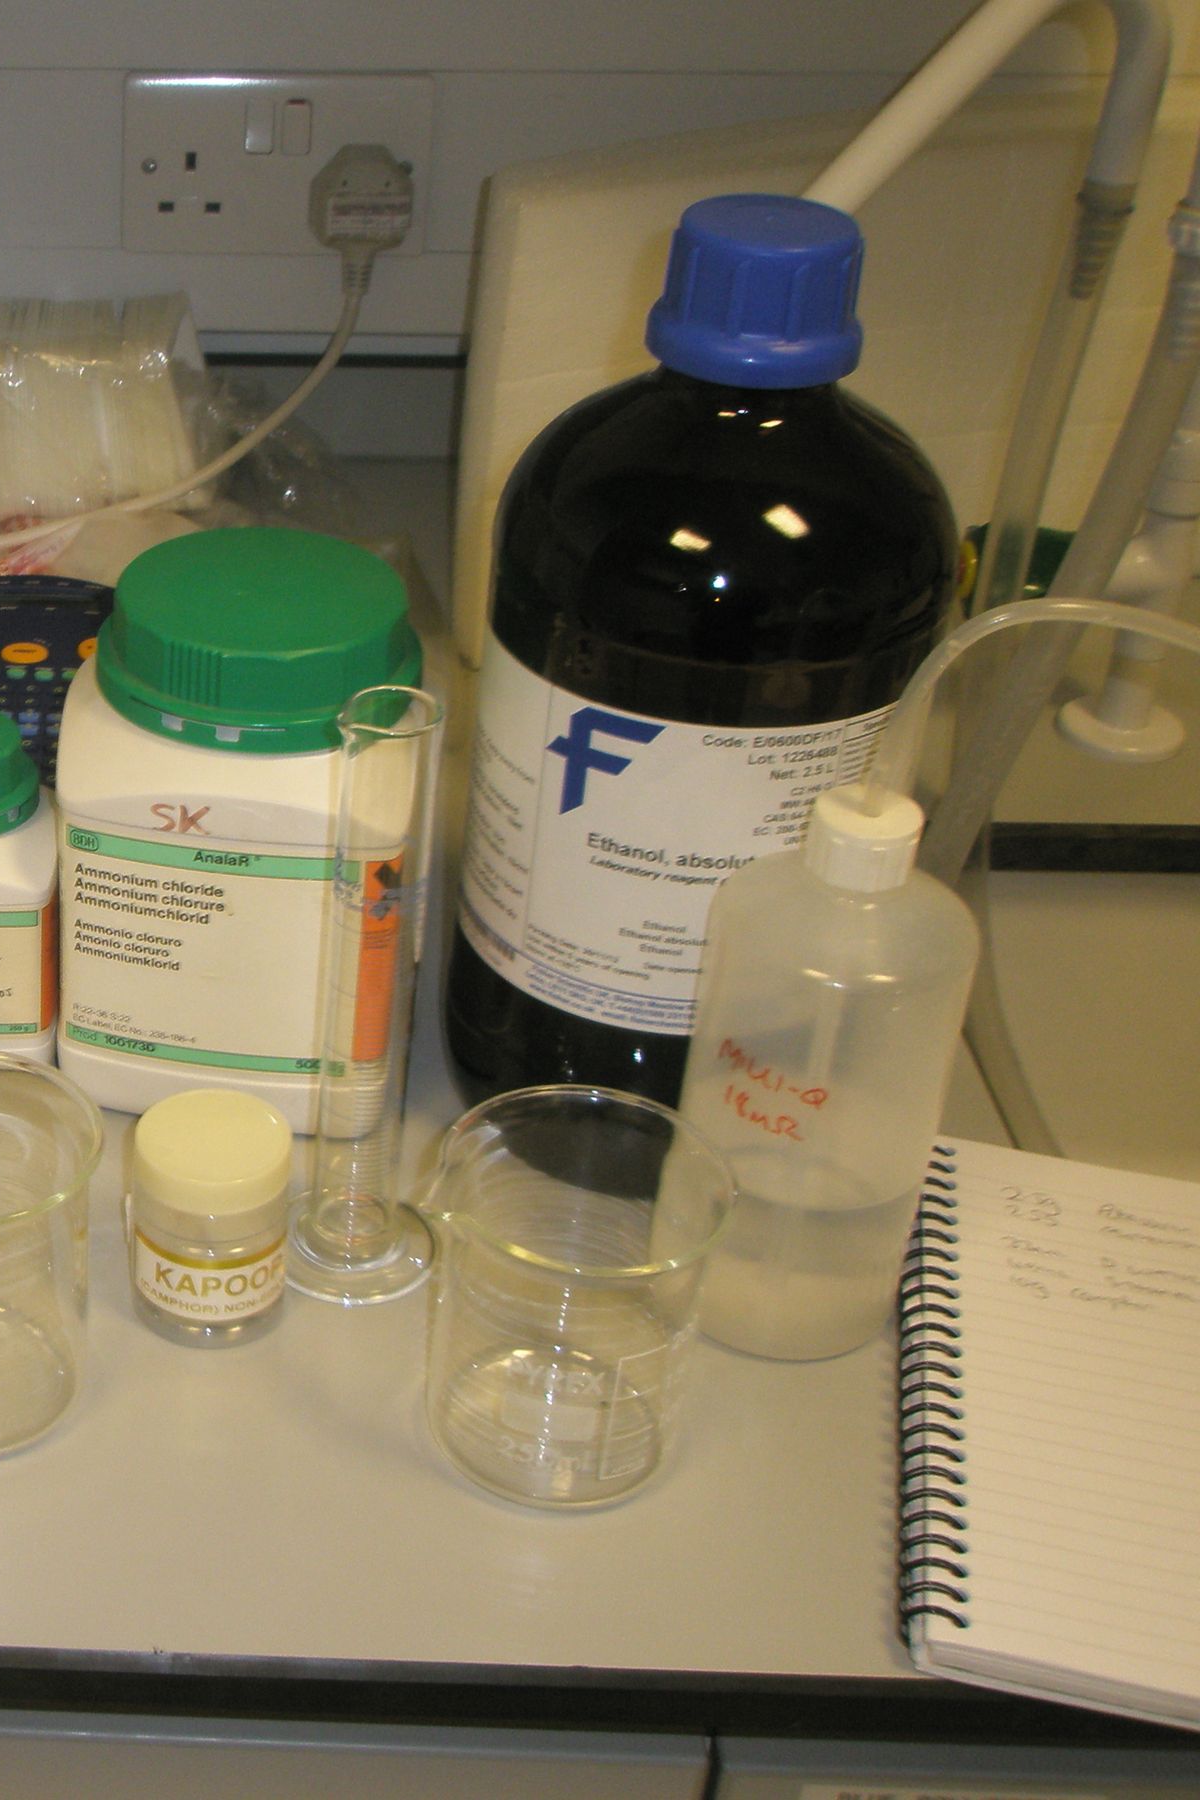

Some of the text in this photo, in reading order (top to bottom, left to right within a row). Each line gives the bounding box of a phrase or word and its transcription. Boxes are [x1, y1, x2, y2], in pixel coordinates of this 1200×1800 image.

[702, 733, 748, 748] Code:
[150, 803, 211, 836] SK
[586, 832, 755, 870] Ethanol, absolut
[74, 863, 225, 898] Ammonium chloride
[589, 855, 661, 881] Laboratory
[663, 872, 718, 886] reagent
[74, 877, 226, 913] Ammonium chlorure
[74, 892, 210, 925] Ammoniumchlorid
[74, 918, 183, 948] Ammonio cloruro
[74, 931, 171, 959] Amonio cloruro
[74, 942, 181, 972] Ammoniumklorid
